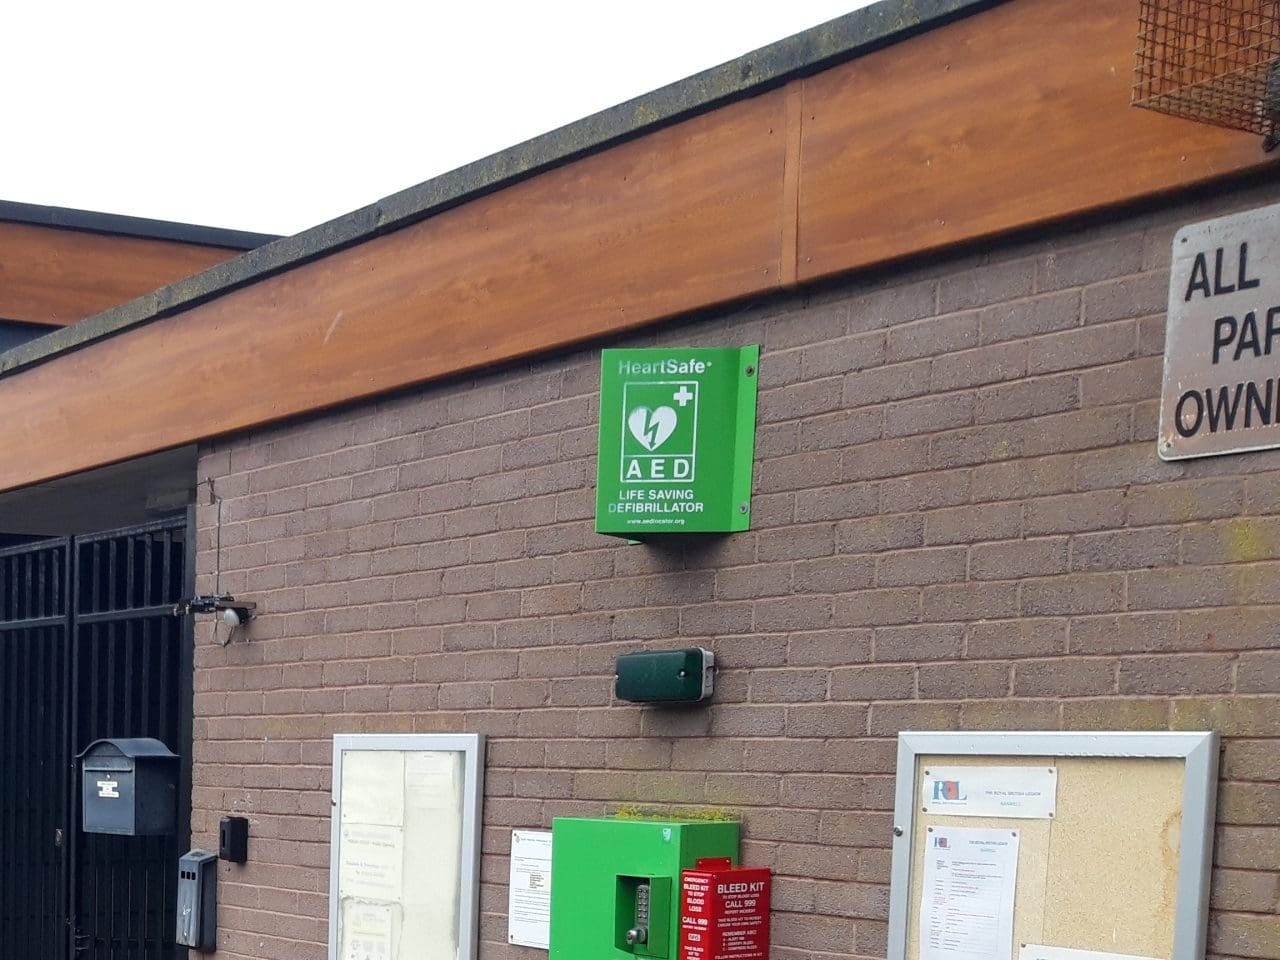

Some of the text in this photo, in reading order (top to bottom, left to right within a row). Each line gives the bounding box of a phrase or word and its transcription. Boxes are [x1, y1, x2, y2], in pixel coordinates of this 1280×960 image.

[1184, 242, 1260, 302] ALL
[619, 358, 706, 374] HeartSafe
[1174, 376, 1280, 438] OWN
[626, 459, 690, 479] AED
[619, 489, 694, 500] LIFE SAVING
[608, 502, 704, 514] DEFIBRILLATOR
[717, 881, 764, 894] BLEED KIT
[724, 899, 756, 908] CALL 999
[682, 916, 697, 925] CALL
